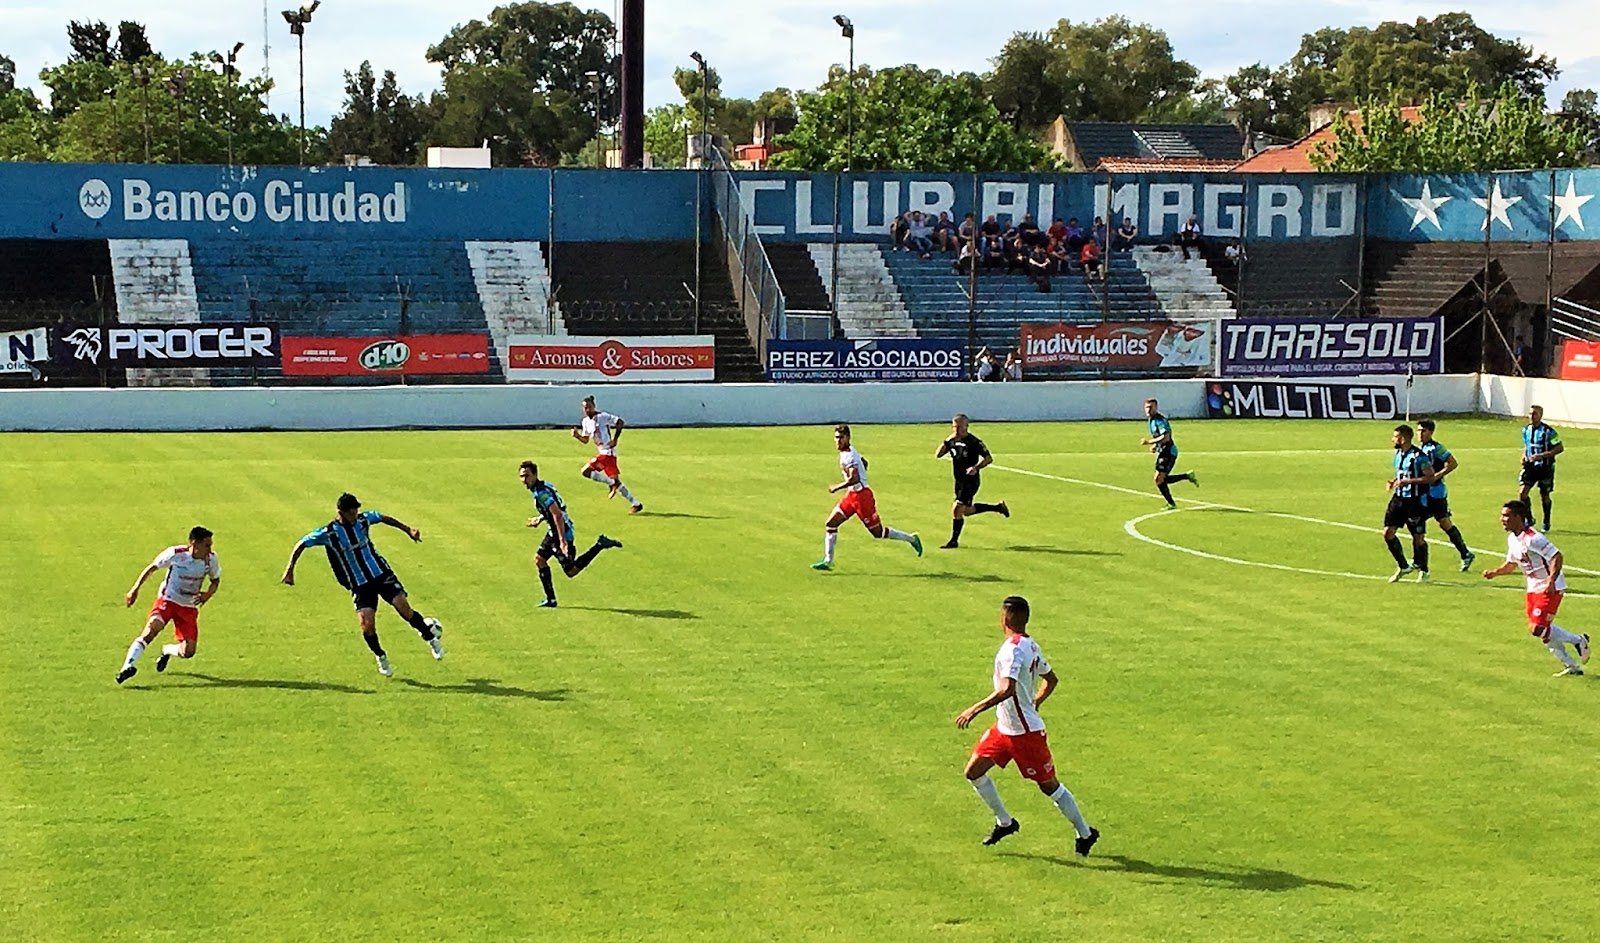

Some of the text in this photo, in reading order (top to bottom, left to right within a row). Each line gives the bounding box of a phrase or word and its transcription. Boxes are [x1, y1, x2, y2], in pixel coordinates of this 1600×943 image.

[122, 178, 407, 223] Banco Ciudad
[108, 327, 274, 358] PROCER
[1026, 333, 1148, 355] individuales
[1226, 322, 1436, 359] TORRESOLD
[529, 347, 694, 370] Aromas & Sabores
[769, 350, 961, 367] PEREZ ASOCIADOS
[1232, 384, 1397, 420] MULTILED
